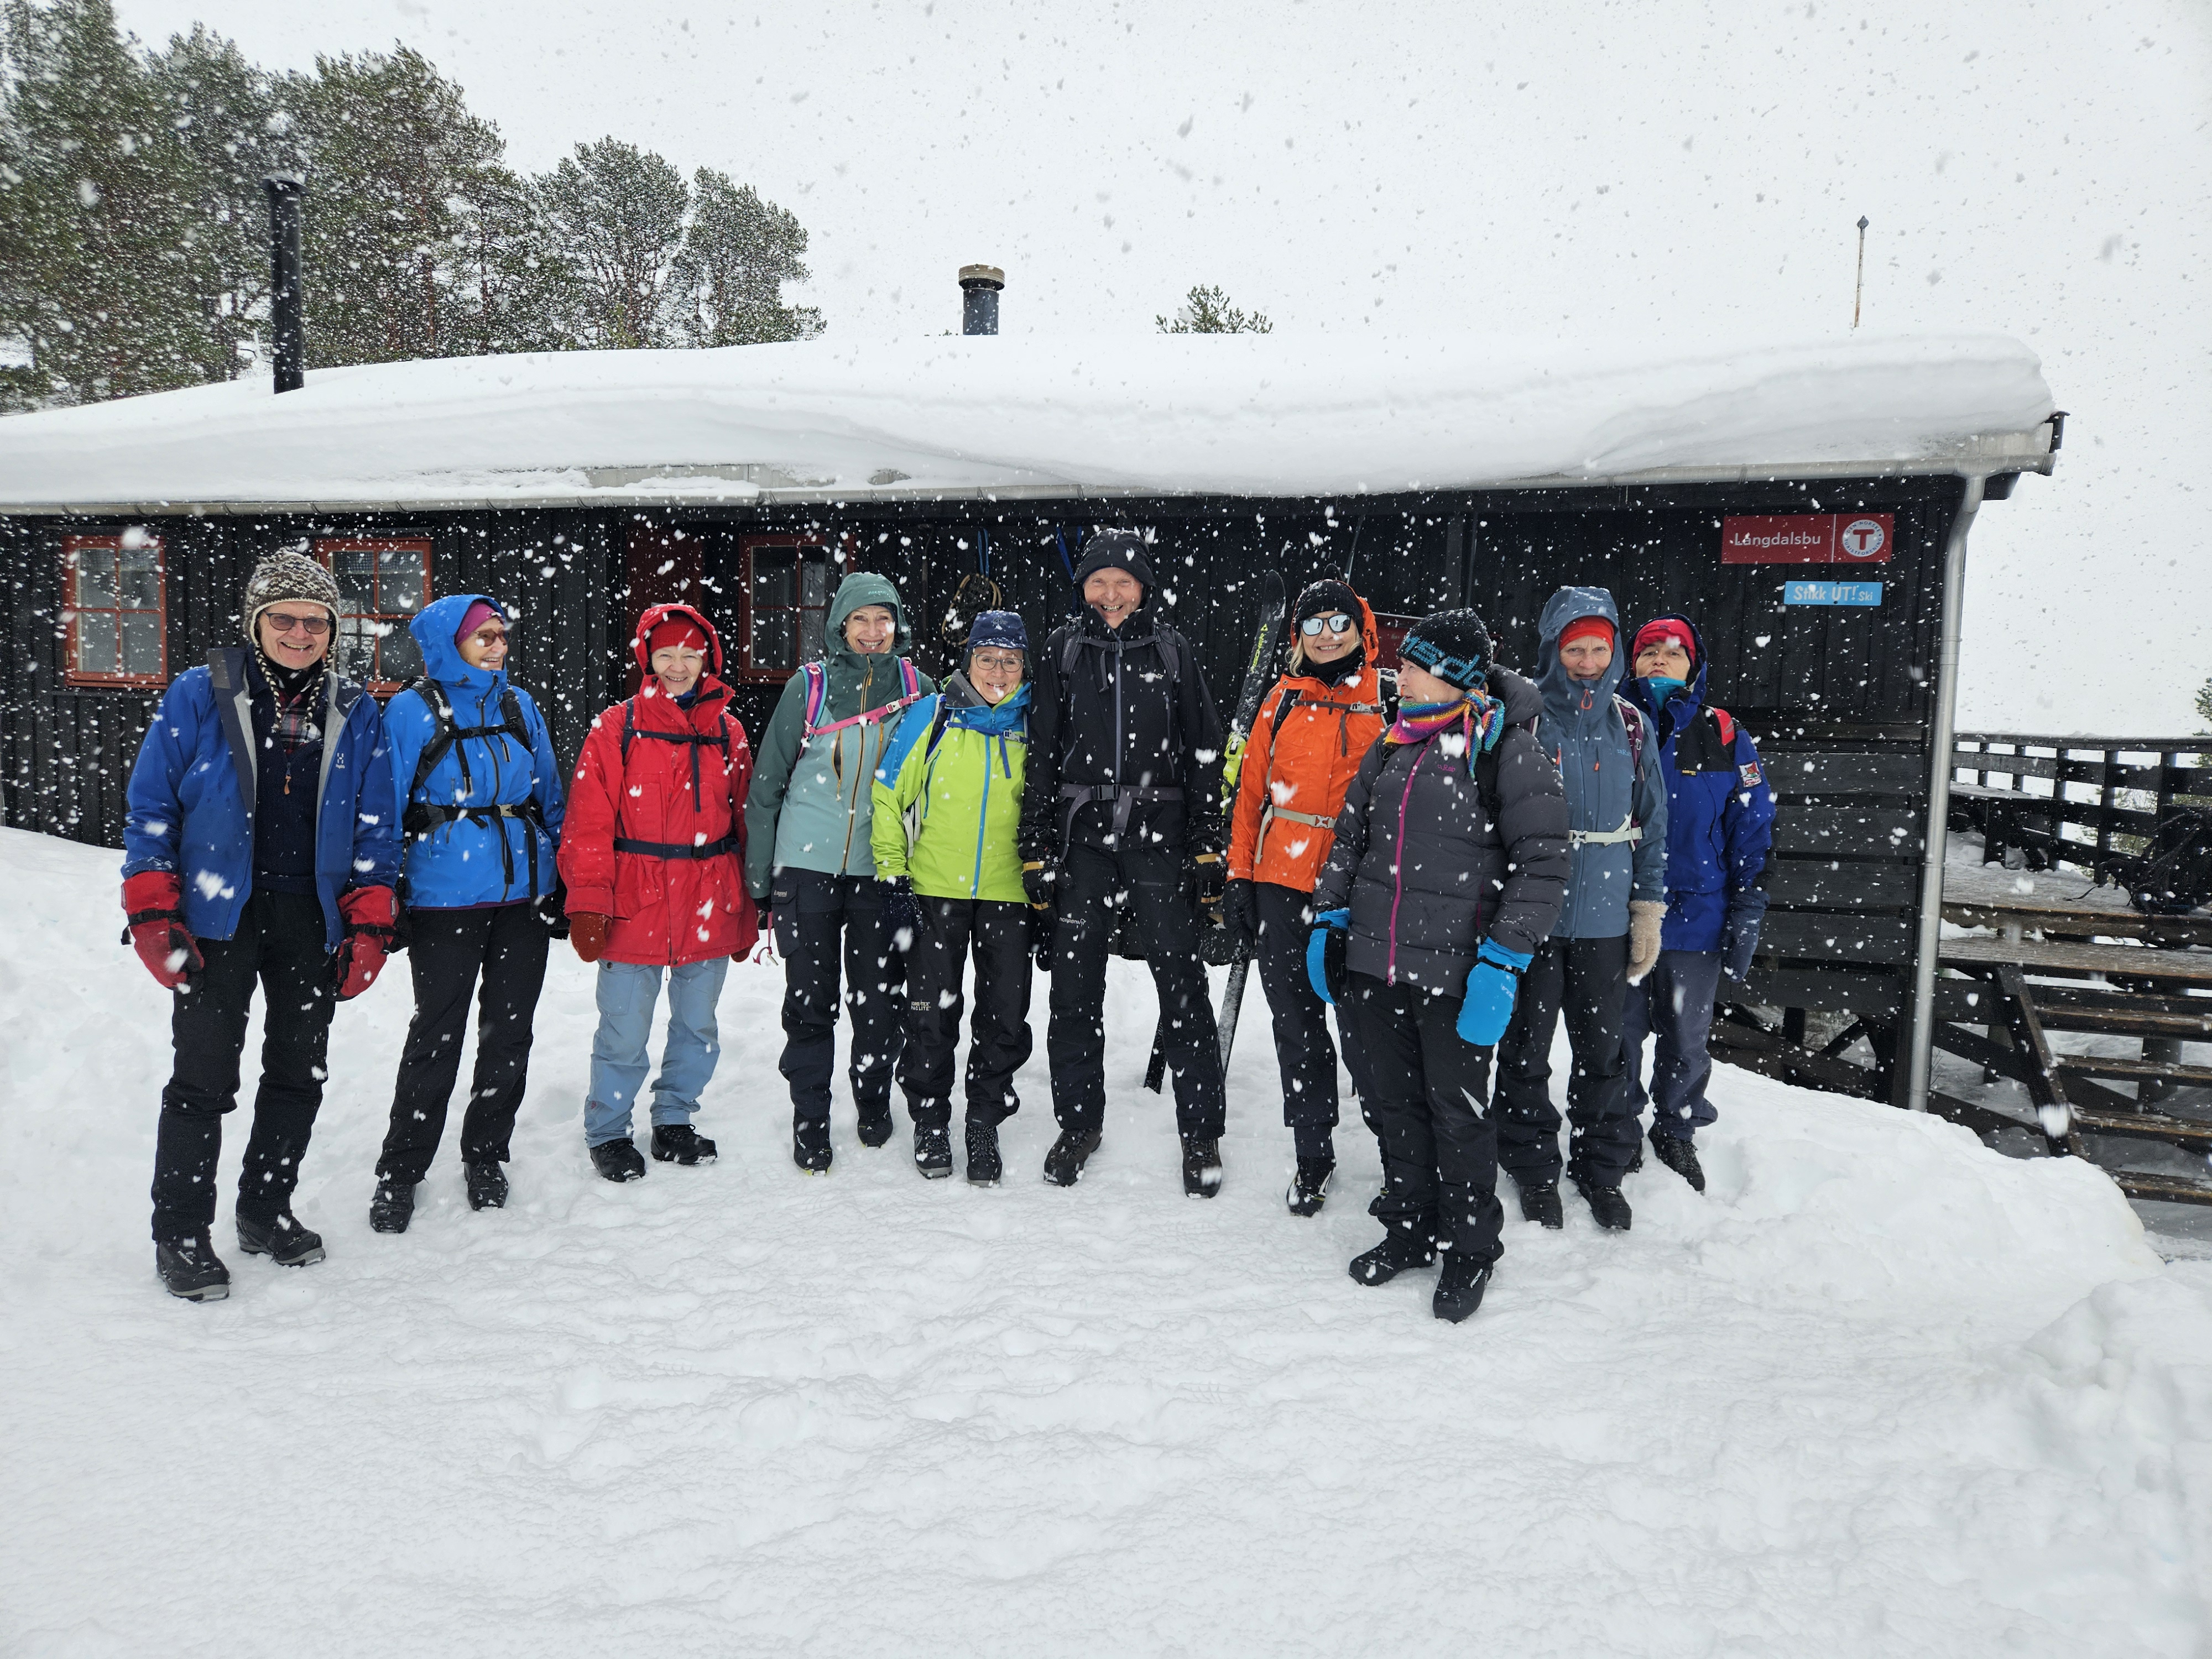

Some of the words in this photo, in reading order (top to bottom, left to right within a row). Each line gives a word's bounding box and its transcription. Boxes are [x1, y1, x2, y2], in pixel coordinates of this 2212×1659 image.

[1846, 523, 1856, 533] DEN
[1853, 529, 1875, 550] T
[1793, 585, 1827, 601] Stikk
[1832, 586, 1857, 601] UT!
[1858, 591, 1873, 602] Ski
